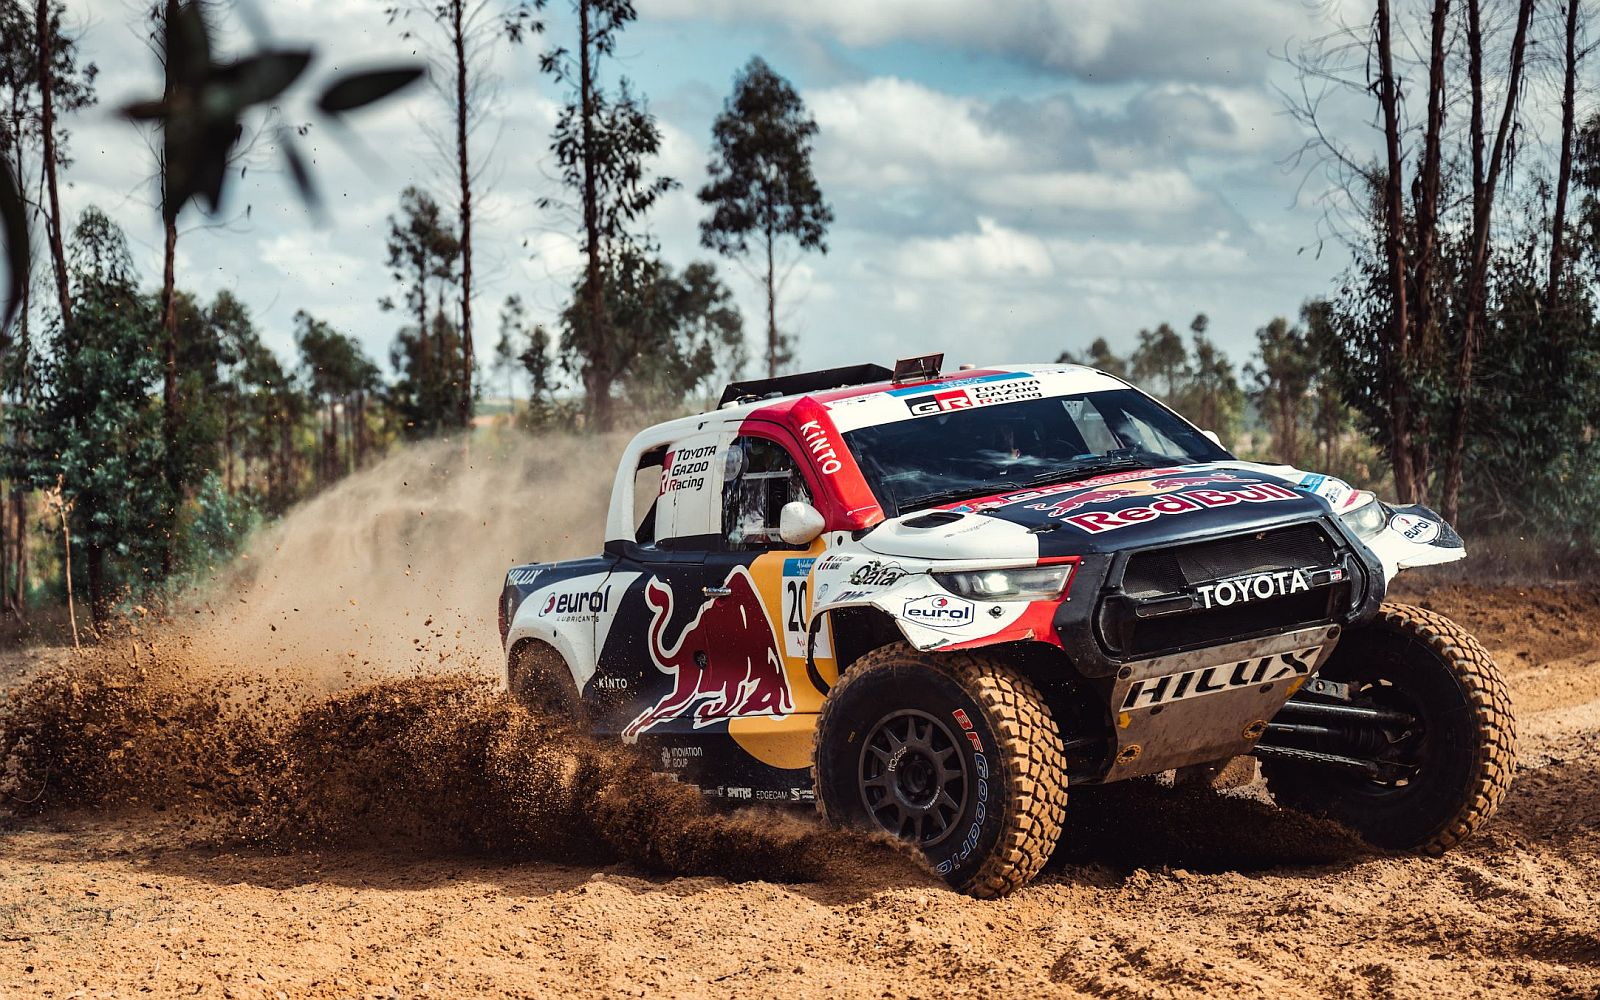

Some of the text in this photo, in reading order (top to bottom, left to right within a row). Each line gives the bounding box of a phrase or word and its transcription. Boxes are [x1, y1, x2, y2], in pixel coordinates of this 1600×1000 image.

[970, 379, 1041, 393] TOYOTA
[975, 386, 1039, 398] GAZOO
[908, 394, 973, 416] GR
[979, 392, 1043, 405] Racing
[677, 446, 717, 461] TOYOTA
[671, 461, 709, 476] GAZOO
[668, 476, 704, 491] Racing
[1060, 495, 1202, 534] Red
[1179, 482, 1304, 508] Bull
[1403, 519, 1432, 539] eurol
[850, 562, 905, 586] Qatar
[555, 585, 612, 613] eurol
[1197, 570, 1310, 609] TOYOTA
[907, 607, 969, 619] eurol
[1122, 647, 1321, 708] HILUX
[936, 708, 989, 877] BFGoodric
